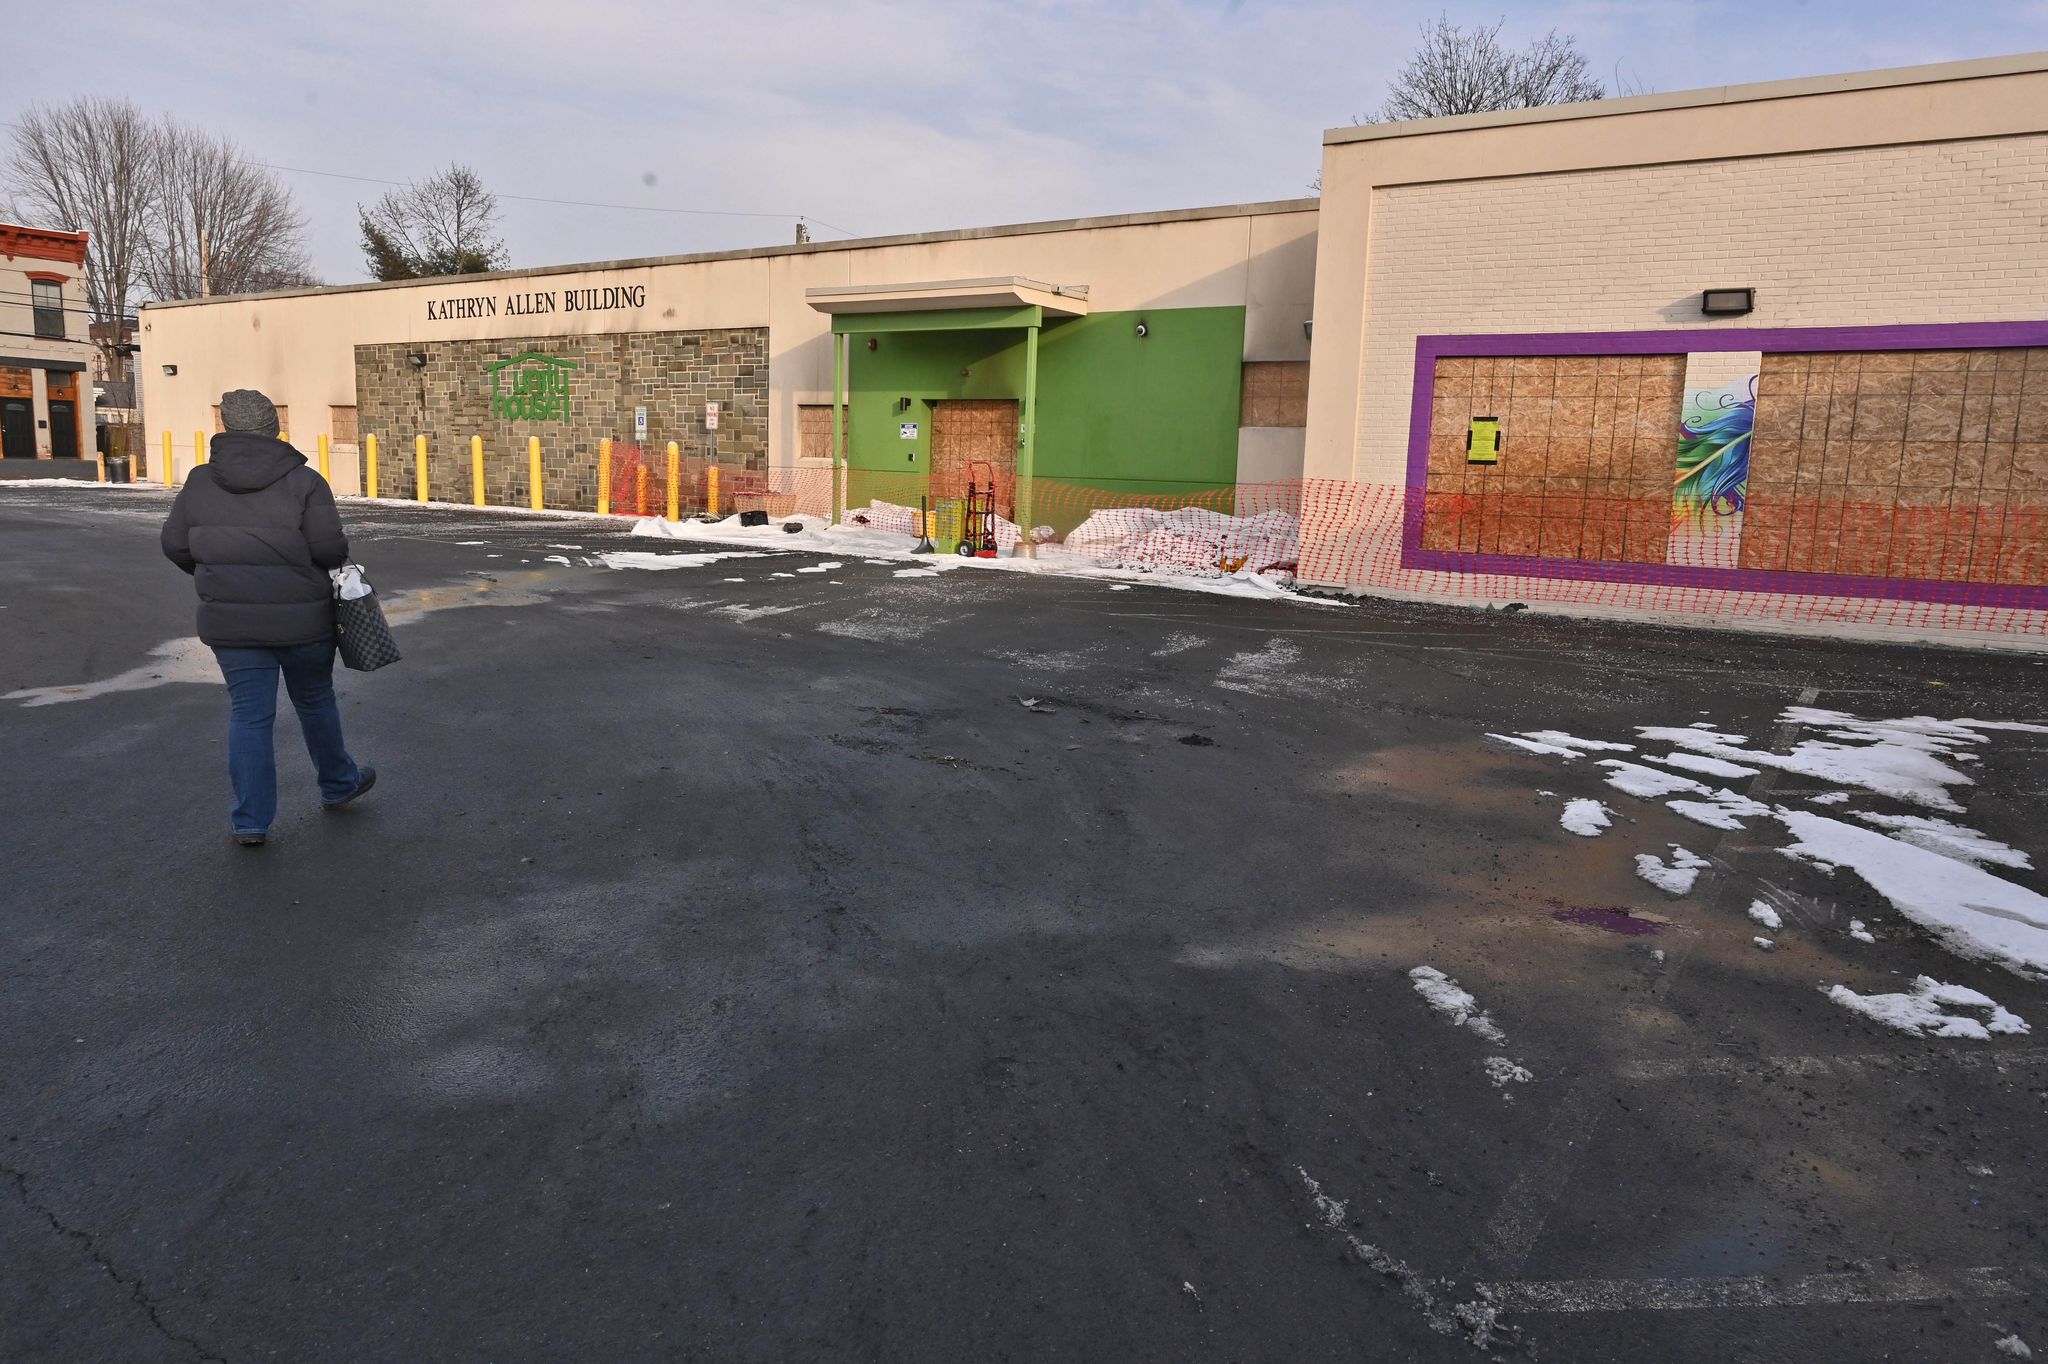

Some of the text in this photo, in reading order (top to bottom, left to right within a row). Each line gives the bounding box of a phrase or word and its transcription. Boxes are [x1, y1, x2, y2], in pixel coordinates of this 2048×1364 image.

[427, 285, 646, 321] KATHRYN ALLEN BUILDING
